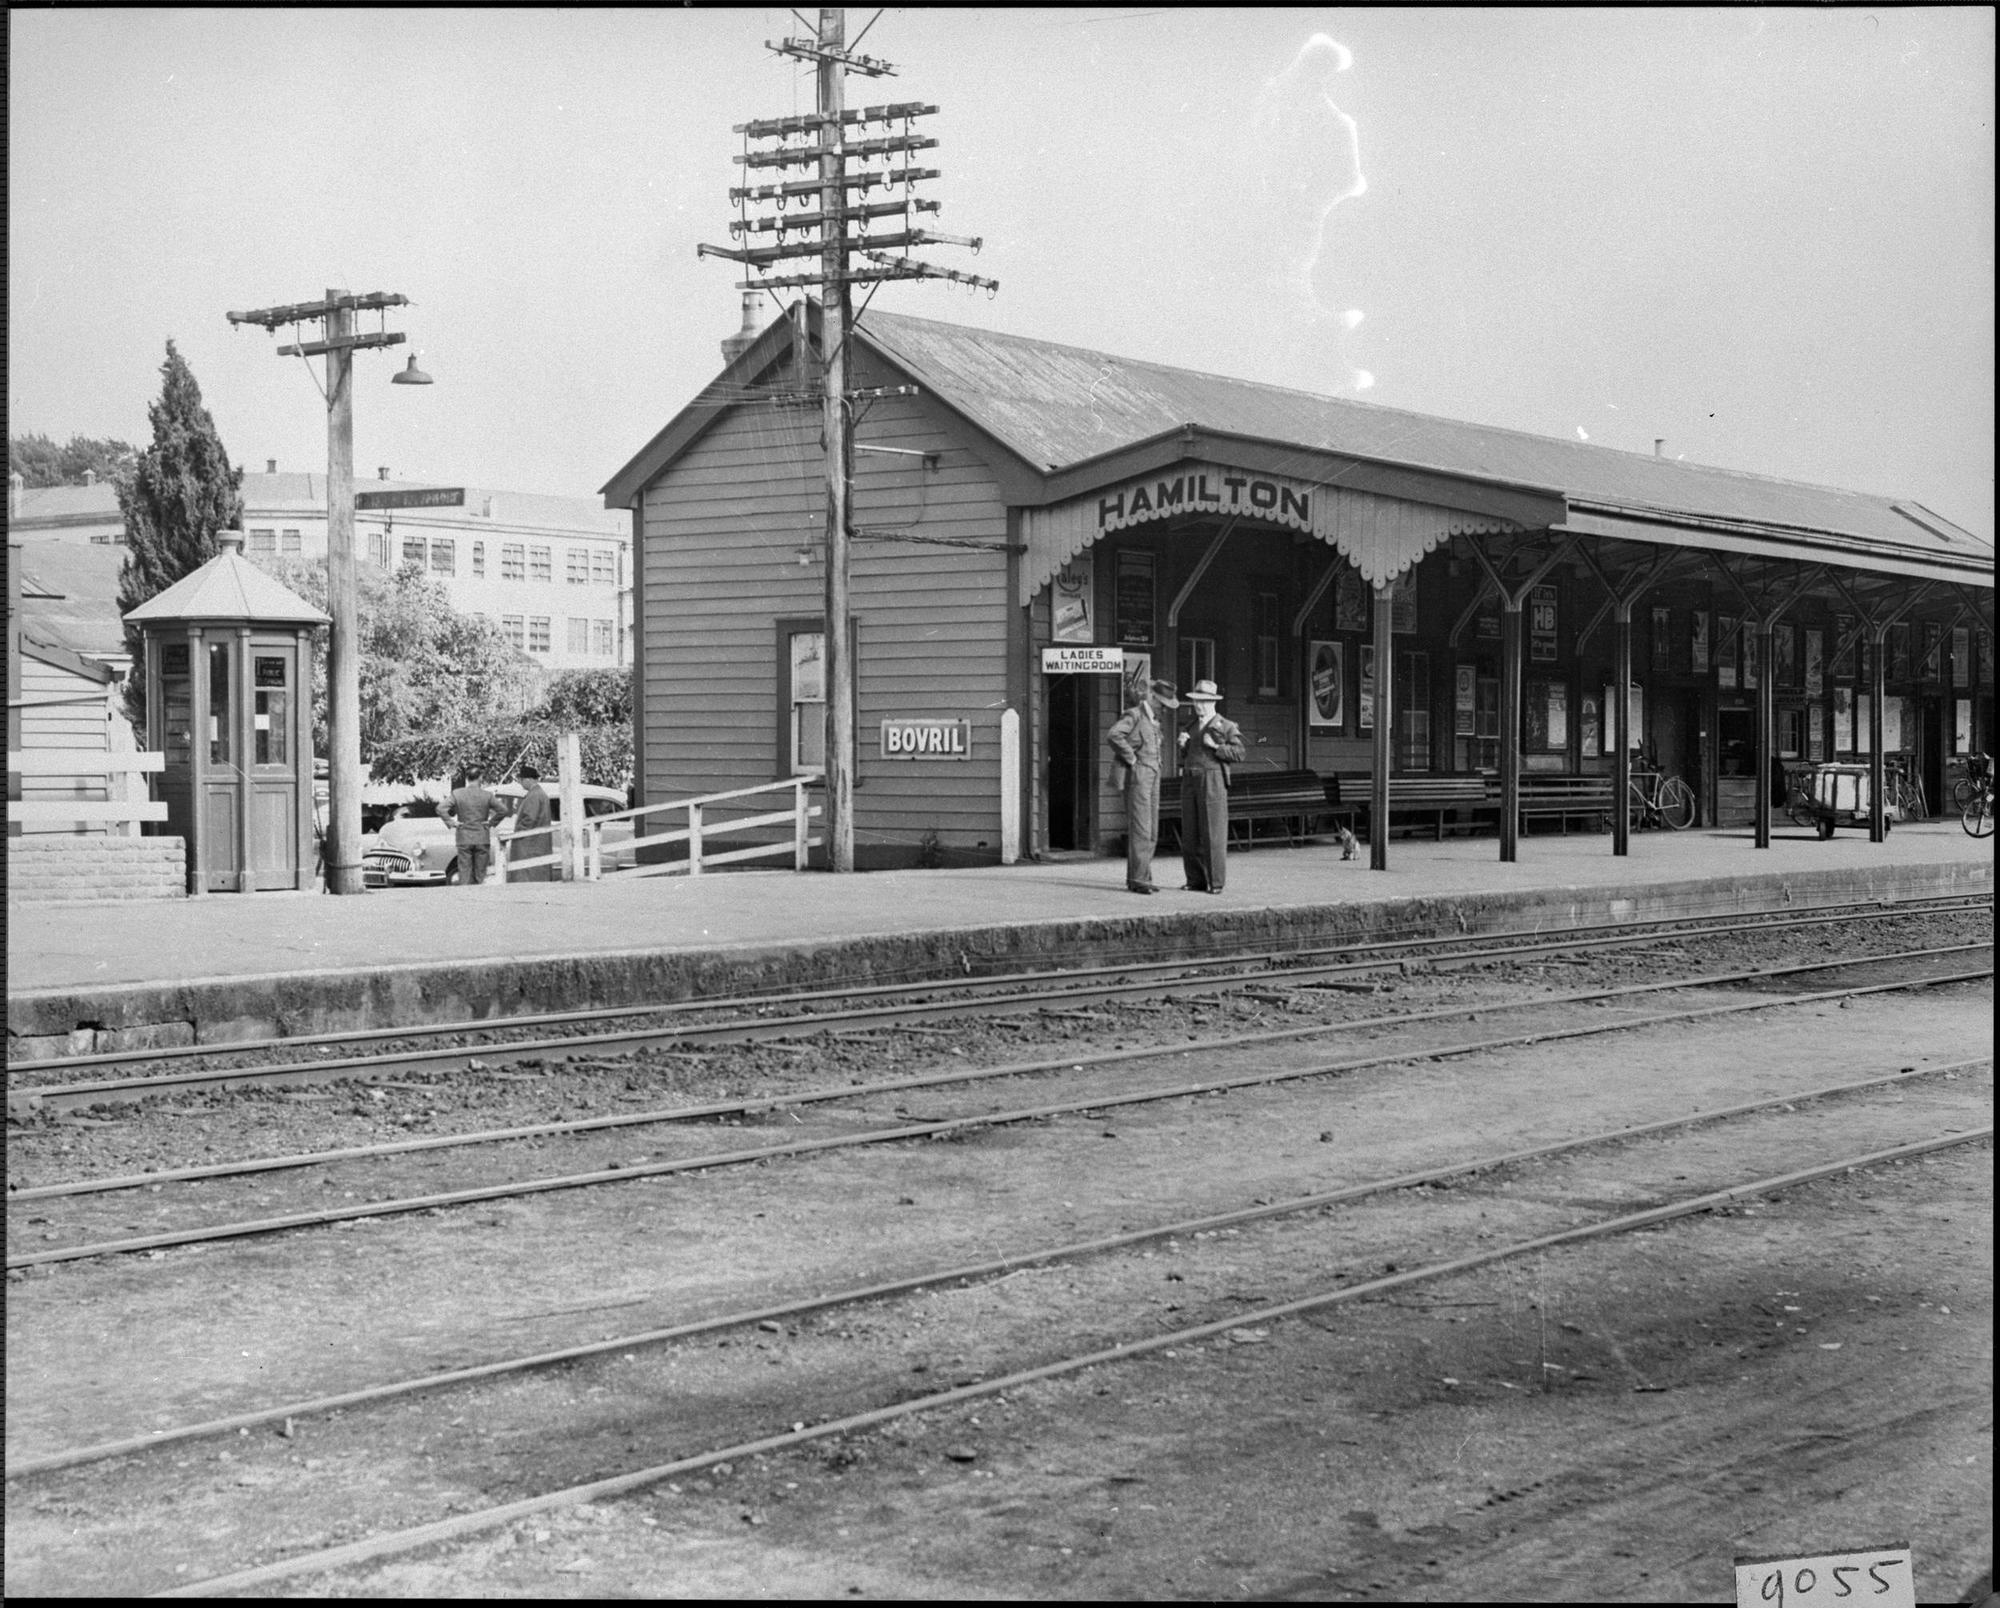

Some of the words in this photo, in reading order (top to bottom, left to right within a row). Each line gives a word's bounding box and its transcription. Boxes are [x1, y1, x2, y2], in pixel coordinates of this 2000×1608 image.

[1099, 475, 1309, 528] HAMILTON
[1060, 650, 1104, 660] LADIES
[888, 727, 964, 752] BOVRIL
[1761, 1559, 1904, 1608] 9055
